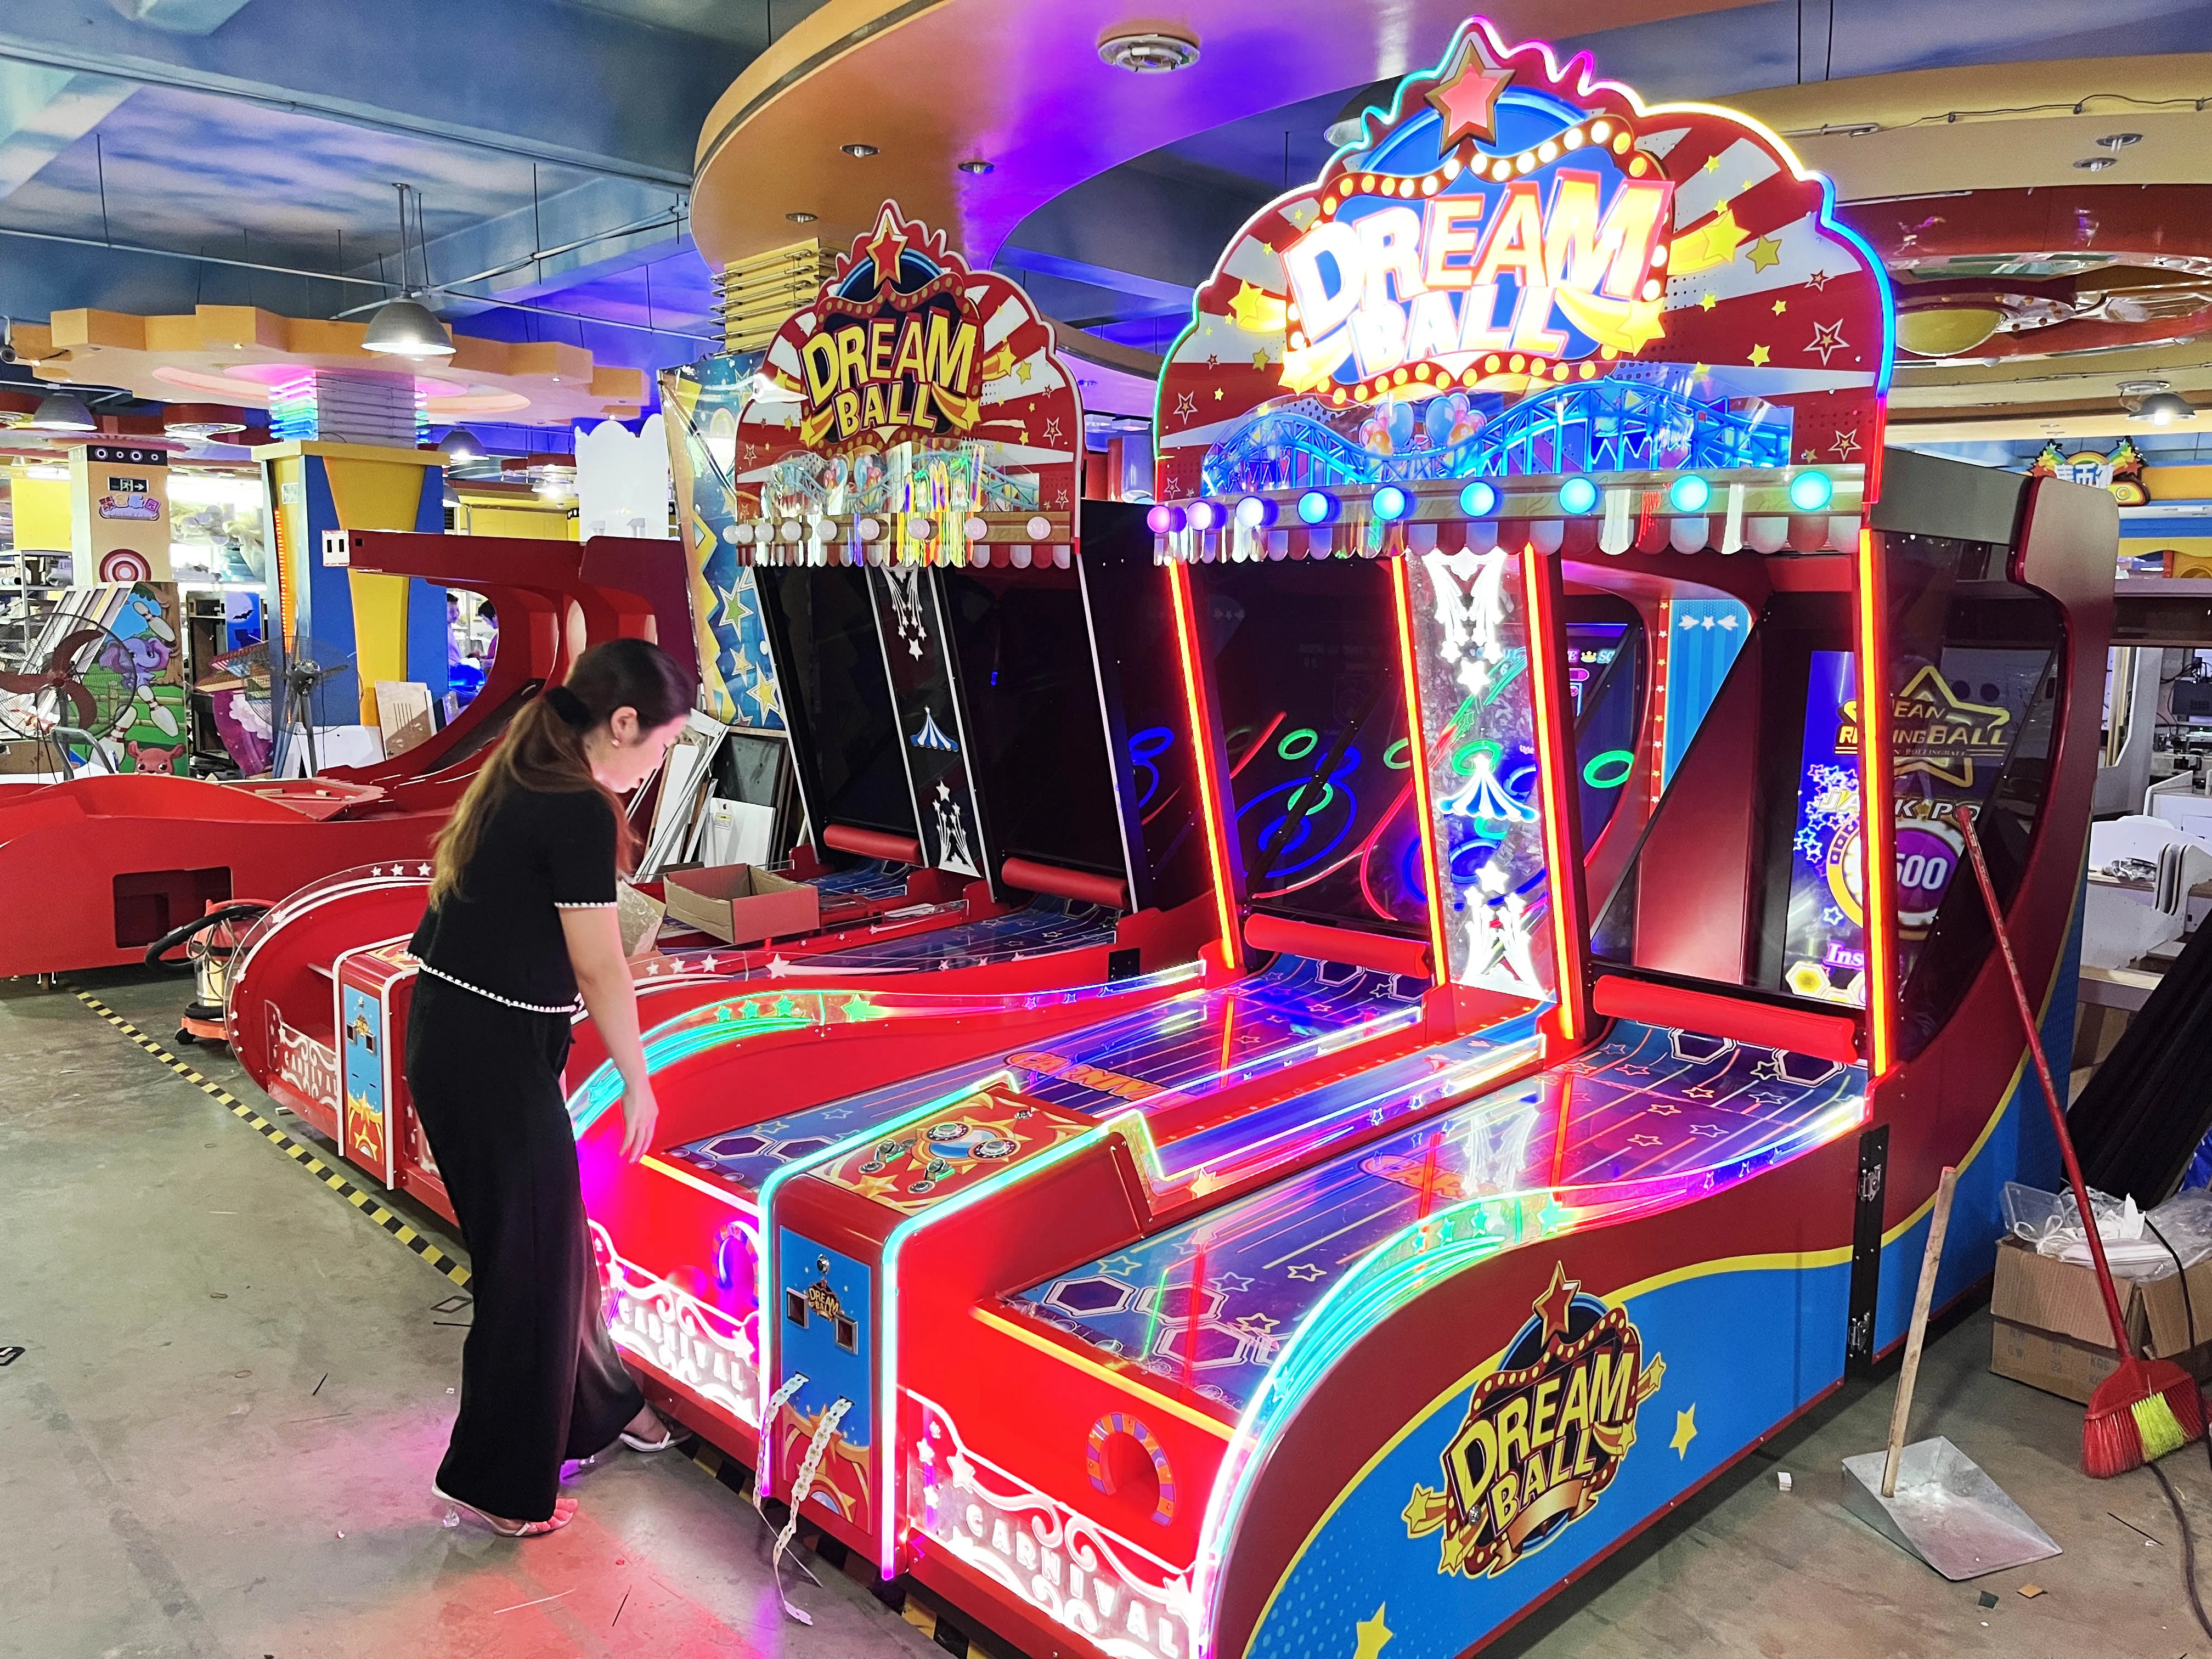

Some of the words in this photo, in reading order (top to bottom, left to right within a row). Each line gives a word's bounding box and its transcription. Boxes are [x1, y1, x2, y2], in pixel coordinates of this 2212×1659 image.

[1280, 170, 1674, 343] DREAM
[801, 311, 978, 405] DREAM
[1348, 284, 1568, 382] BALL
[835, 381, 938, 440] BALL
[618, 1297, 746, 1392] CARNIVAL
[809, 1287, 839, 1313] DREAM
[815, 1301, 833, 1317] BALL
[1449, 1351, 1636, 1512] DREAM
[1490, 1427, 1597, 1532] BALL
[964, 1503, 1180, 1658] CARNIVAL
